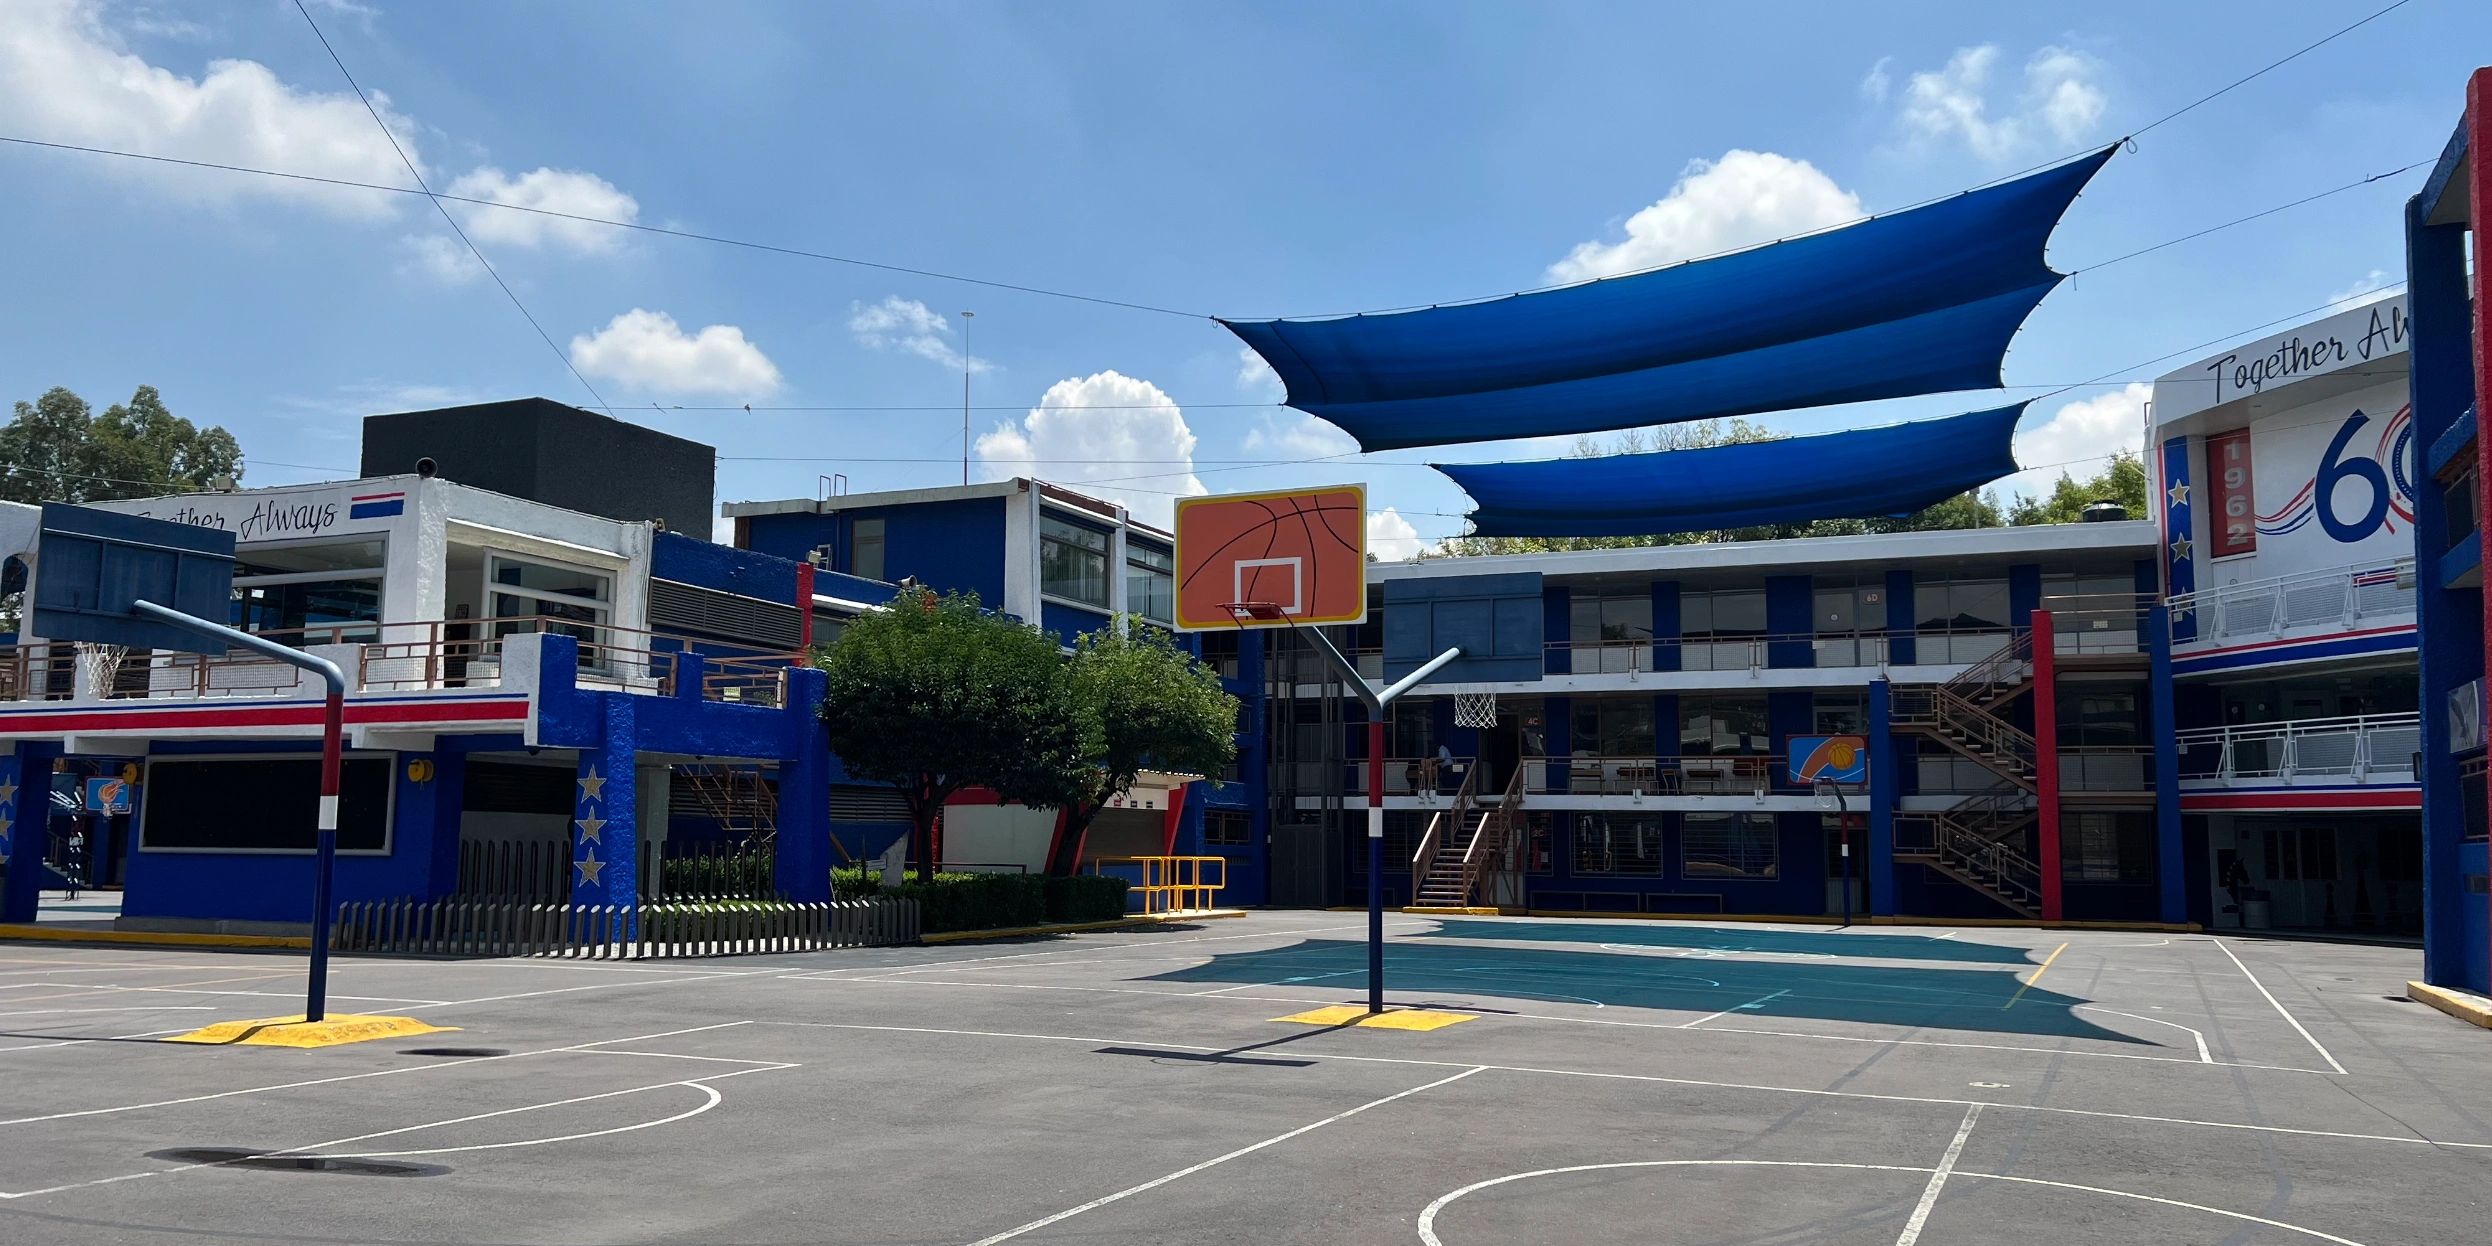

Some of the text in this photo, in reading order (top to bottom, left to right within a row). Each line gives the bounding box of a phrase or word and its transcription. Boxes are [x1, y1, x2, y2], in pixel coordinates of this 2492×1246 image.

[2207, 336, 2349, 404] Together
[2223, 441, 2248, 546] 1962
[240, 500, 339, 540] Always
[1866, 593, 1879, 602] 6D
[1527, 717, 1539, 726] 4C
